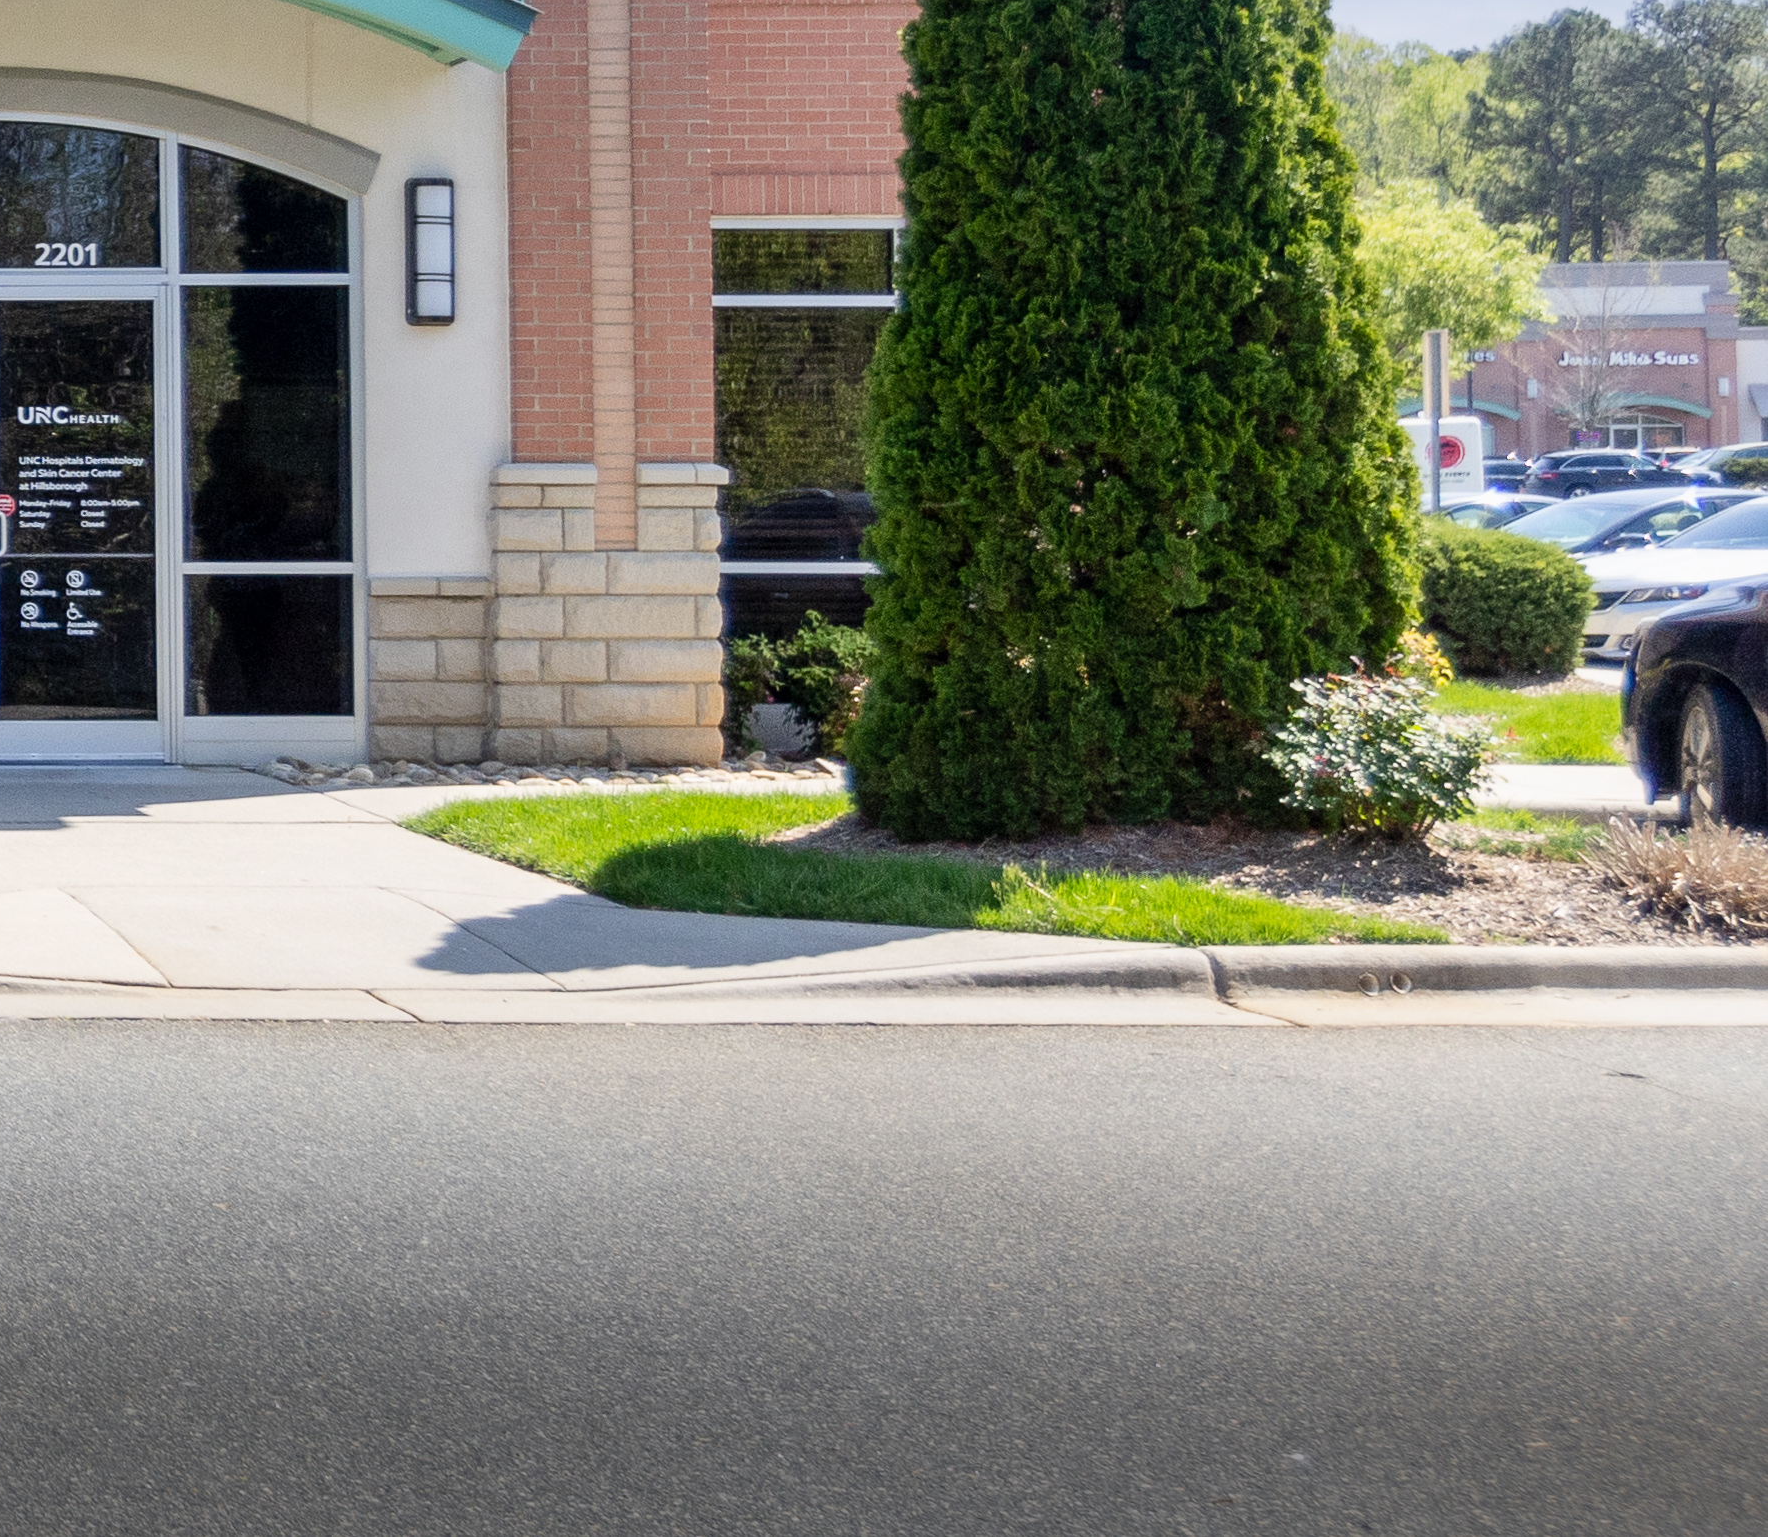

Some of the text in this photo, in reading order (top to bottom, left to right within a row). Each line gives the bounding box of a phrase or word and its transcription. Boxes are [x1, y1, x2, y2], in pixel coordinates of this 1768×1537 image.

[34, 242, 97, 266] 2201
[17, 406, 120, 424] UNC HEALTH
[18, 456, 145, 467] UNC Hospitals Dermatology
[18, 469, 123, 478] and Skin Cancer Center
[18, 482, 89, 493] at Hillsborough
